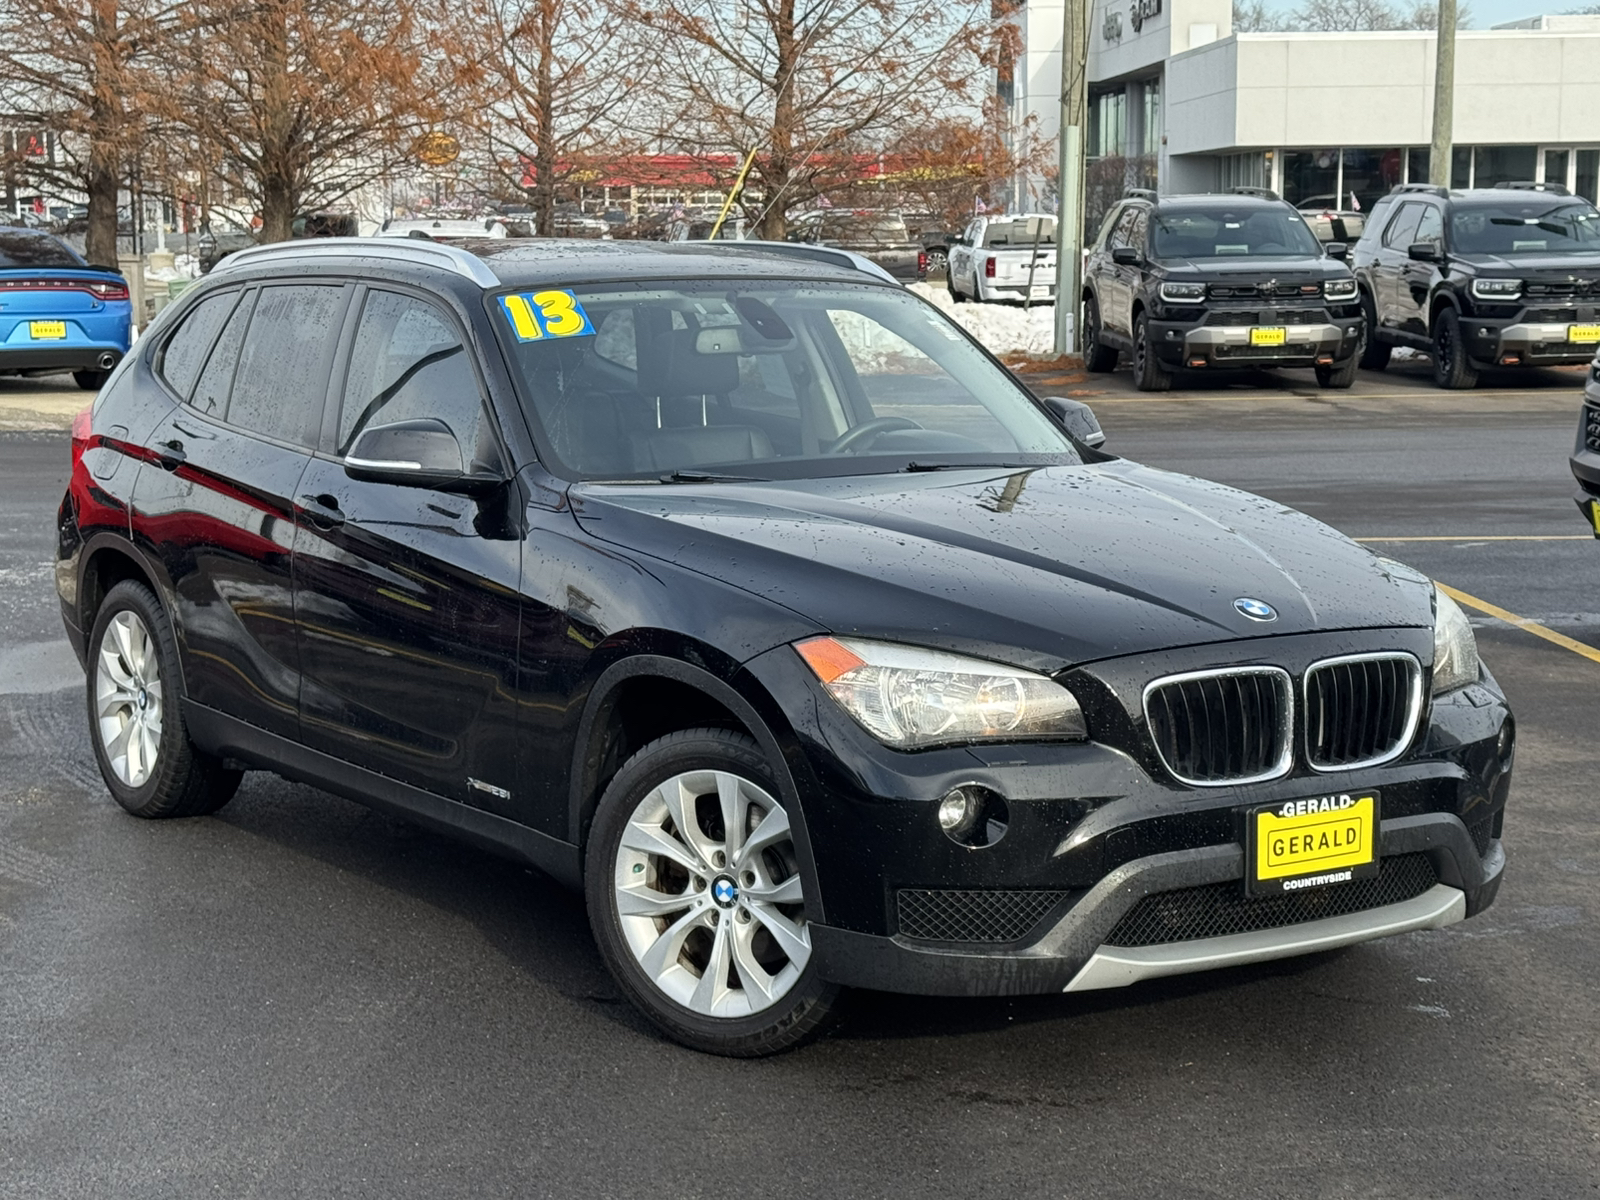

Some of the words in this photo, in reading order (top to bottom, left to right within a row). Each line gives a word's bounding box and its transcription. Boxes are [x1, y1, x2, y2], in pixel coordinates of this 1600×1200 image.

[505, 290, 585, 339] 13
[1272, 827, 1357, 857] GERALD
[1283, 871, 1352, 890] COUNTRYSIDE
